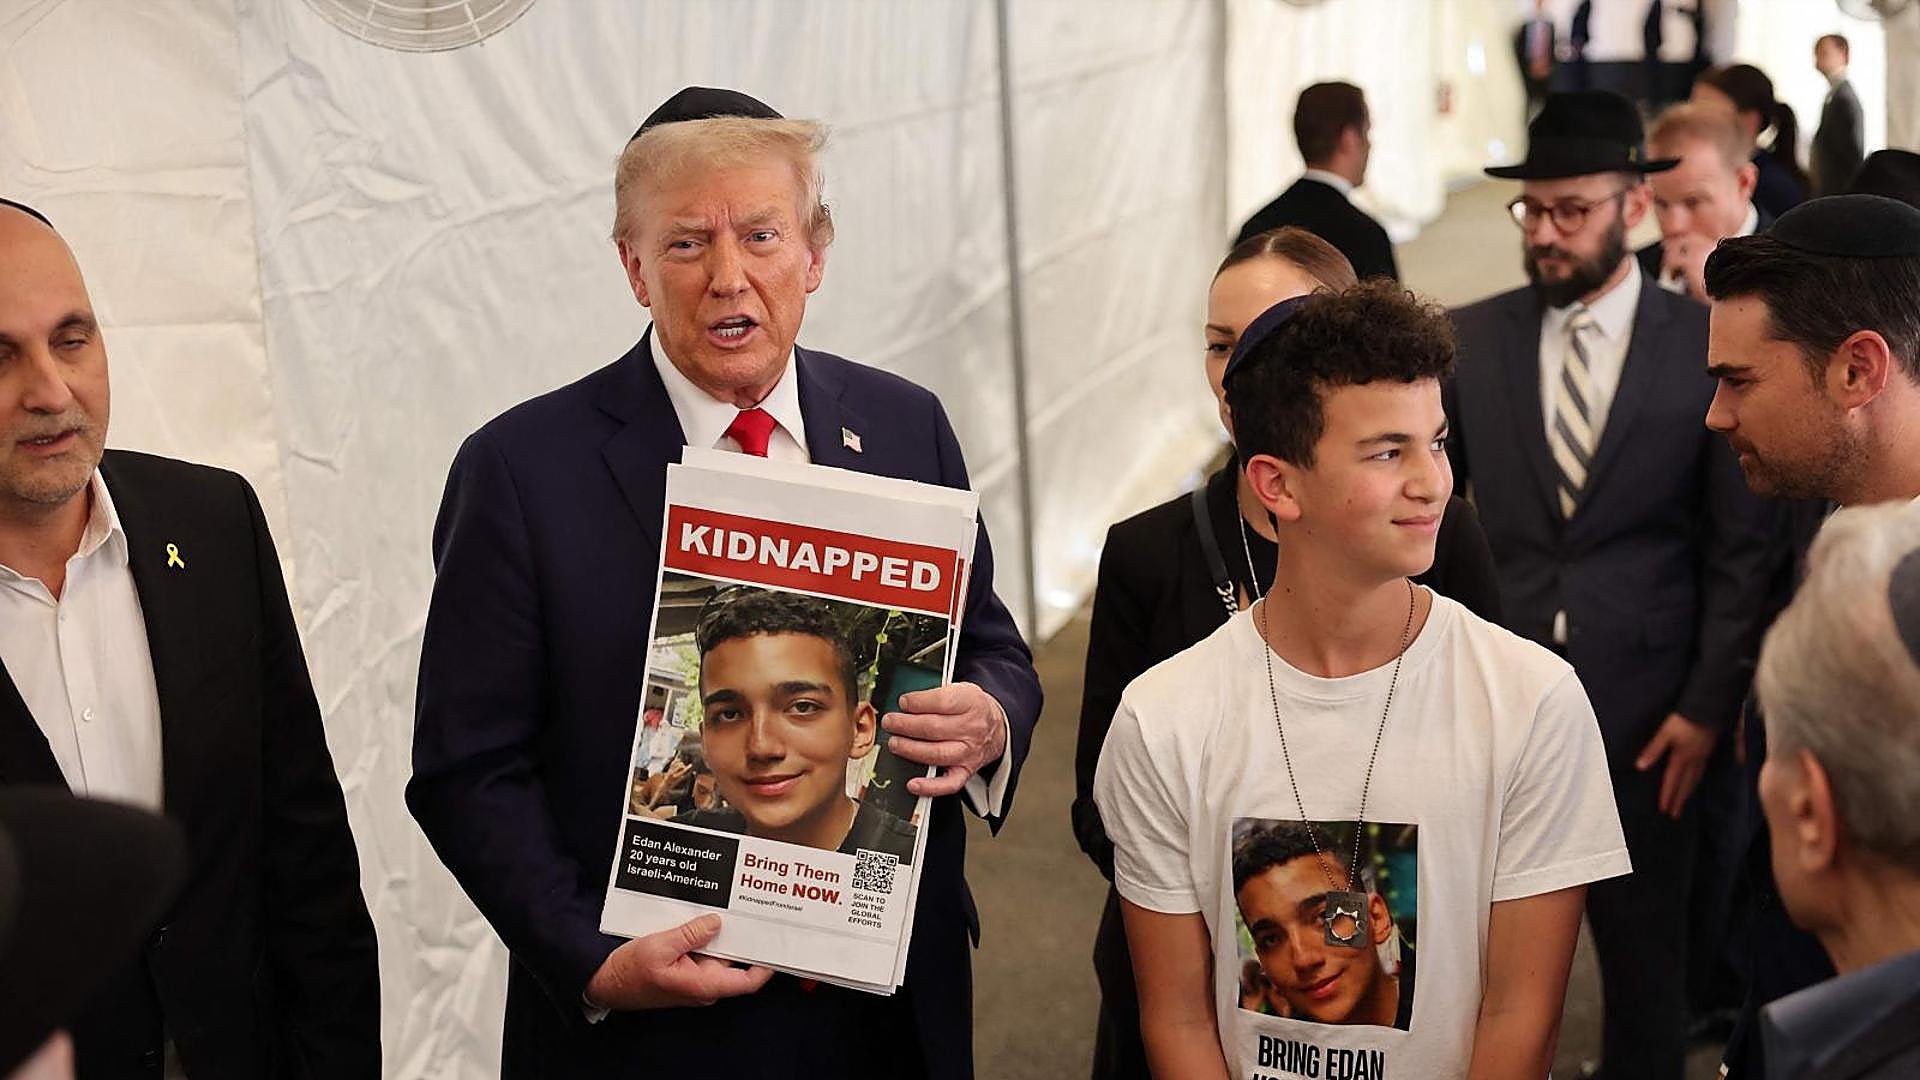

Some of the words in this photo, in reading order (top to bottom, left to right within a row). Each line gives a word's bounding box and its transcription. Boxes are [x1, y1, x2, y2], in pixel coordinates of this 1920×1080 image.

[681, 522, 941, 592] KIDNAPPED
[629, 849, 643, 860] 20
[645, 853, 676, 867] years
[679, 860, 697, 871] old
[632, 834, 661, 849] Edan
[663, 841, 721, 861] Alexander
[627, 863, 719, 890] Israeli-American
[744, 853, 789, 876] Bring
[794, 862, 840, 883] Them
[740, 873, 788, 894] Home
[792, 883, 842, 905] NOW.
[853, 893, 874, 902] SCAN
[851, 901, 868, 910] JOIN
[870, 904, 885, 912] THE
[851, 909, 880, 919] GLOBAL
[847, 916, 882, 928] EFFORTS
[1258, 1035, 1320, 1078] BRING
[1325, 1048, 1385, 1080] EDAN
